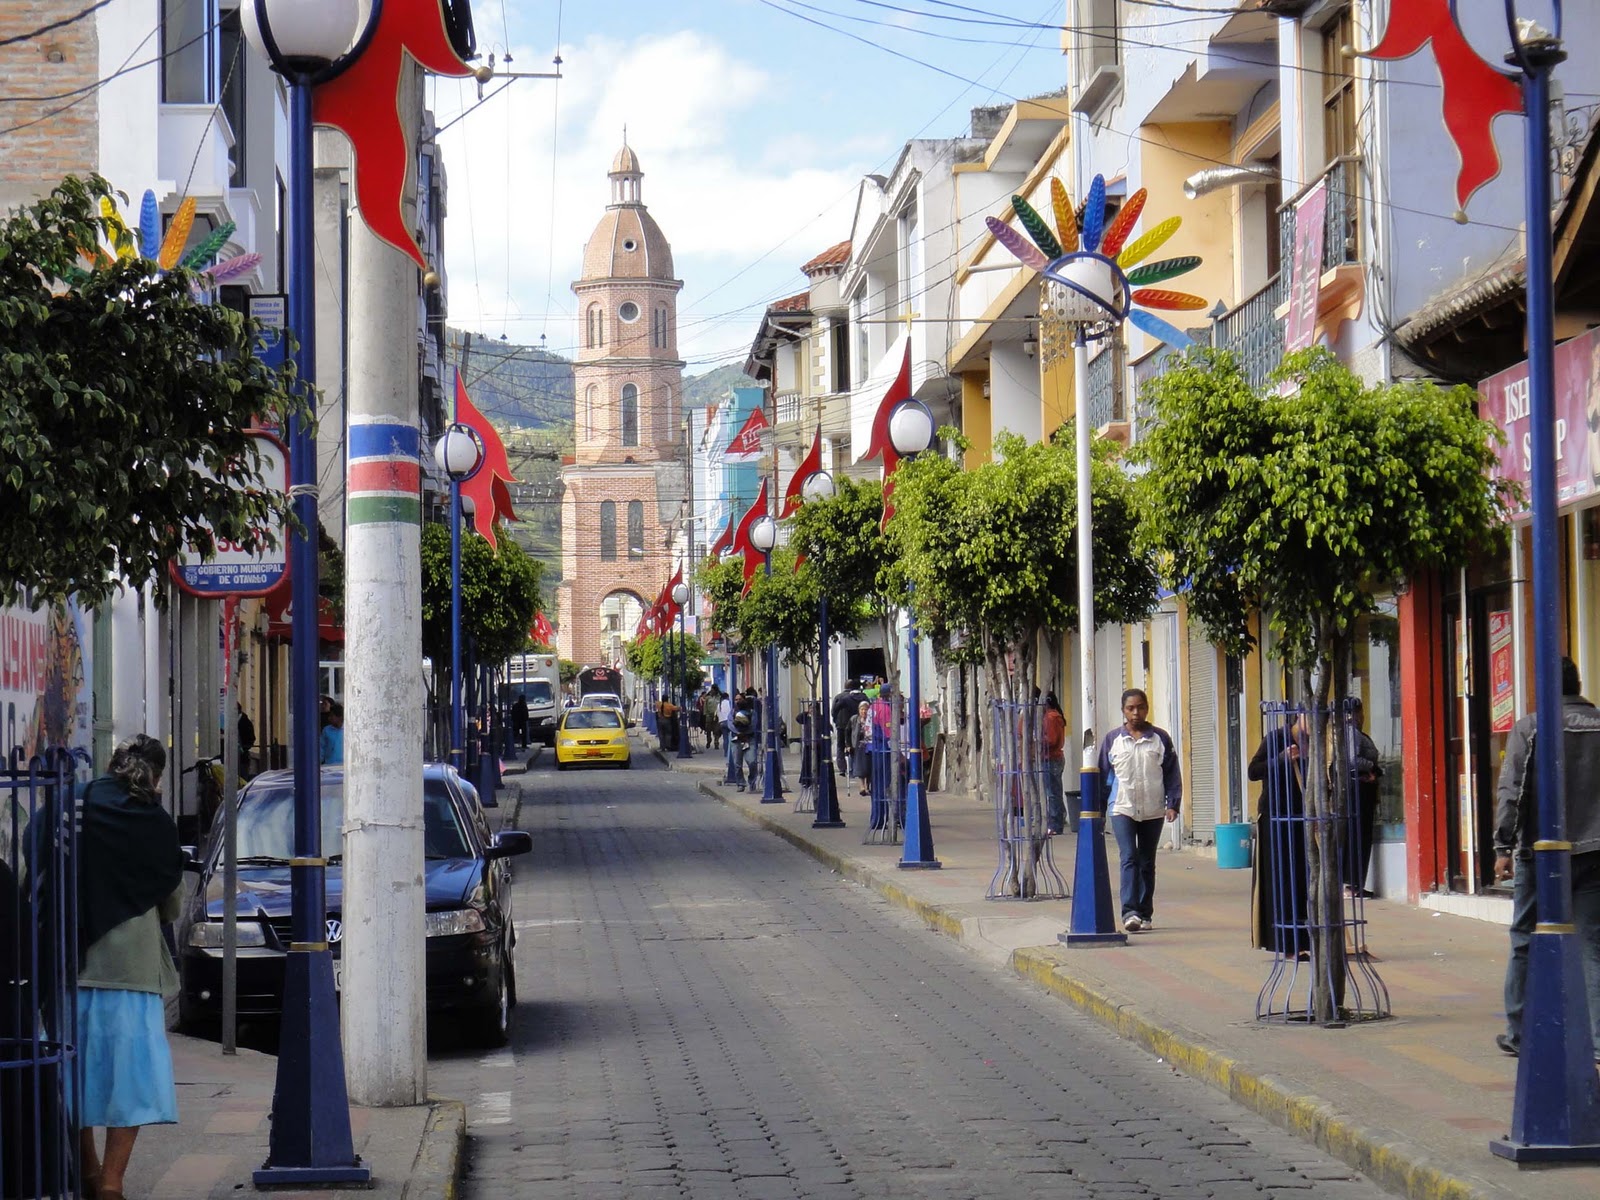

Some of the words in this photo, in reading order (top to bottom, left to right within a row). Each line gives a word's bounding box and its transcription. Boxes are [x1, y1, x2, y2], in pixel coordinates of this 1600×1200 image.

[197, 565, 239, 576] GOBIERNO
[240, 563, 283, 574] MUNICIPAL
[219, 575, 232, 585] DE
